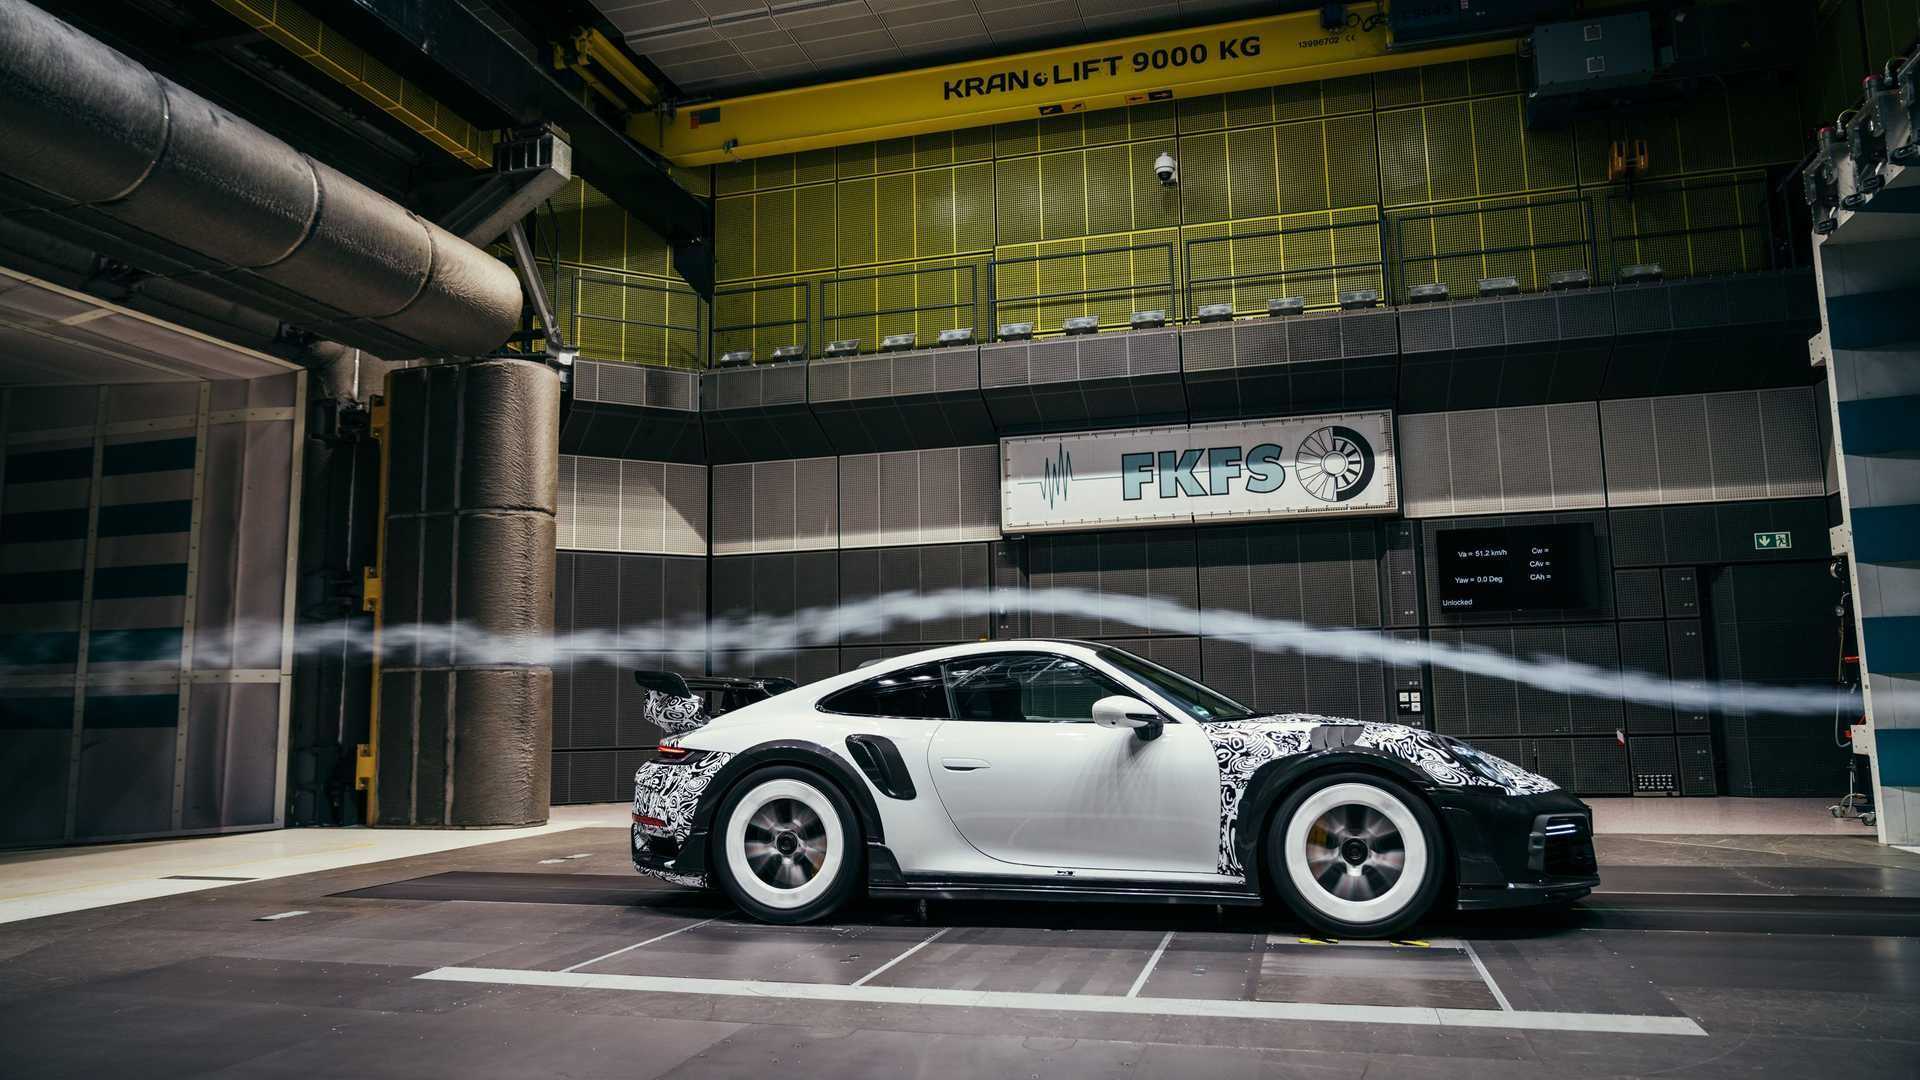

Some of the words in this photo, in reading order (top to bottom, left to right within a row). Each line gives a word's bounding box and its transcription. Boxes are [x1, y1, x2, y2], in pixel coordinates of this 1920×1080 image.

[943, 69, 1029, 100] KRAN
[1052, 55, 1124, 84] LIFT
[1132, 43, 1208, 73] 9000
[1219, 36, 1261, 61] KG
[1121, 443, 1287, 501] FKFS
